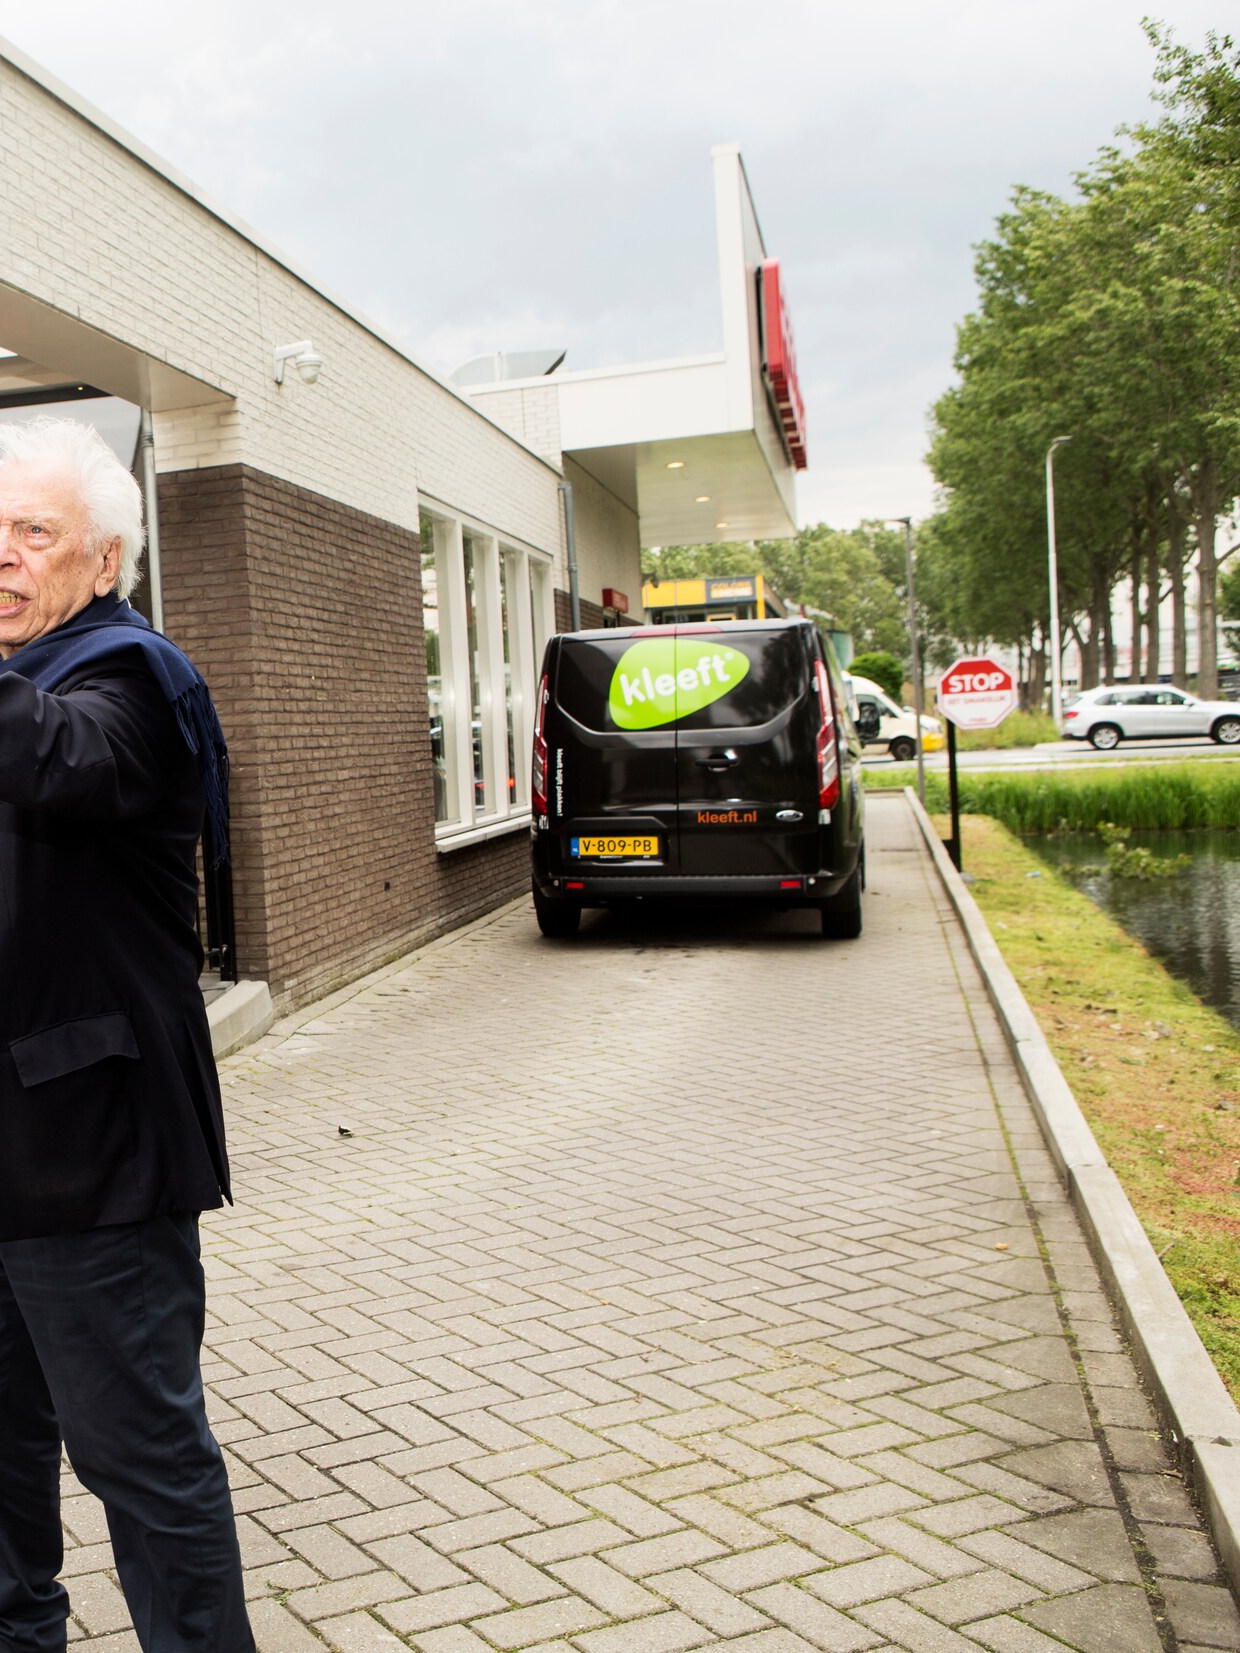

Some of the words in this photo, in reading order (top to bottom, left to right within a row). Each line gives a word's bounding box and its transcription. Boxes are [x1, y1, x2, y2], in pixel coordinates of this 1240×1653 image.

[620, 654, 731, 706] kleeft
[948, 671, 1005, 693] STOP
[697, 810, 758, 824] kleeft.nl
[582, 839, 652, 853] V-809-PB
